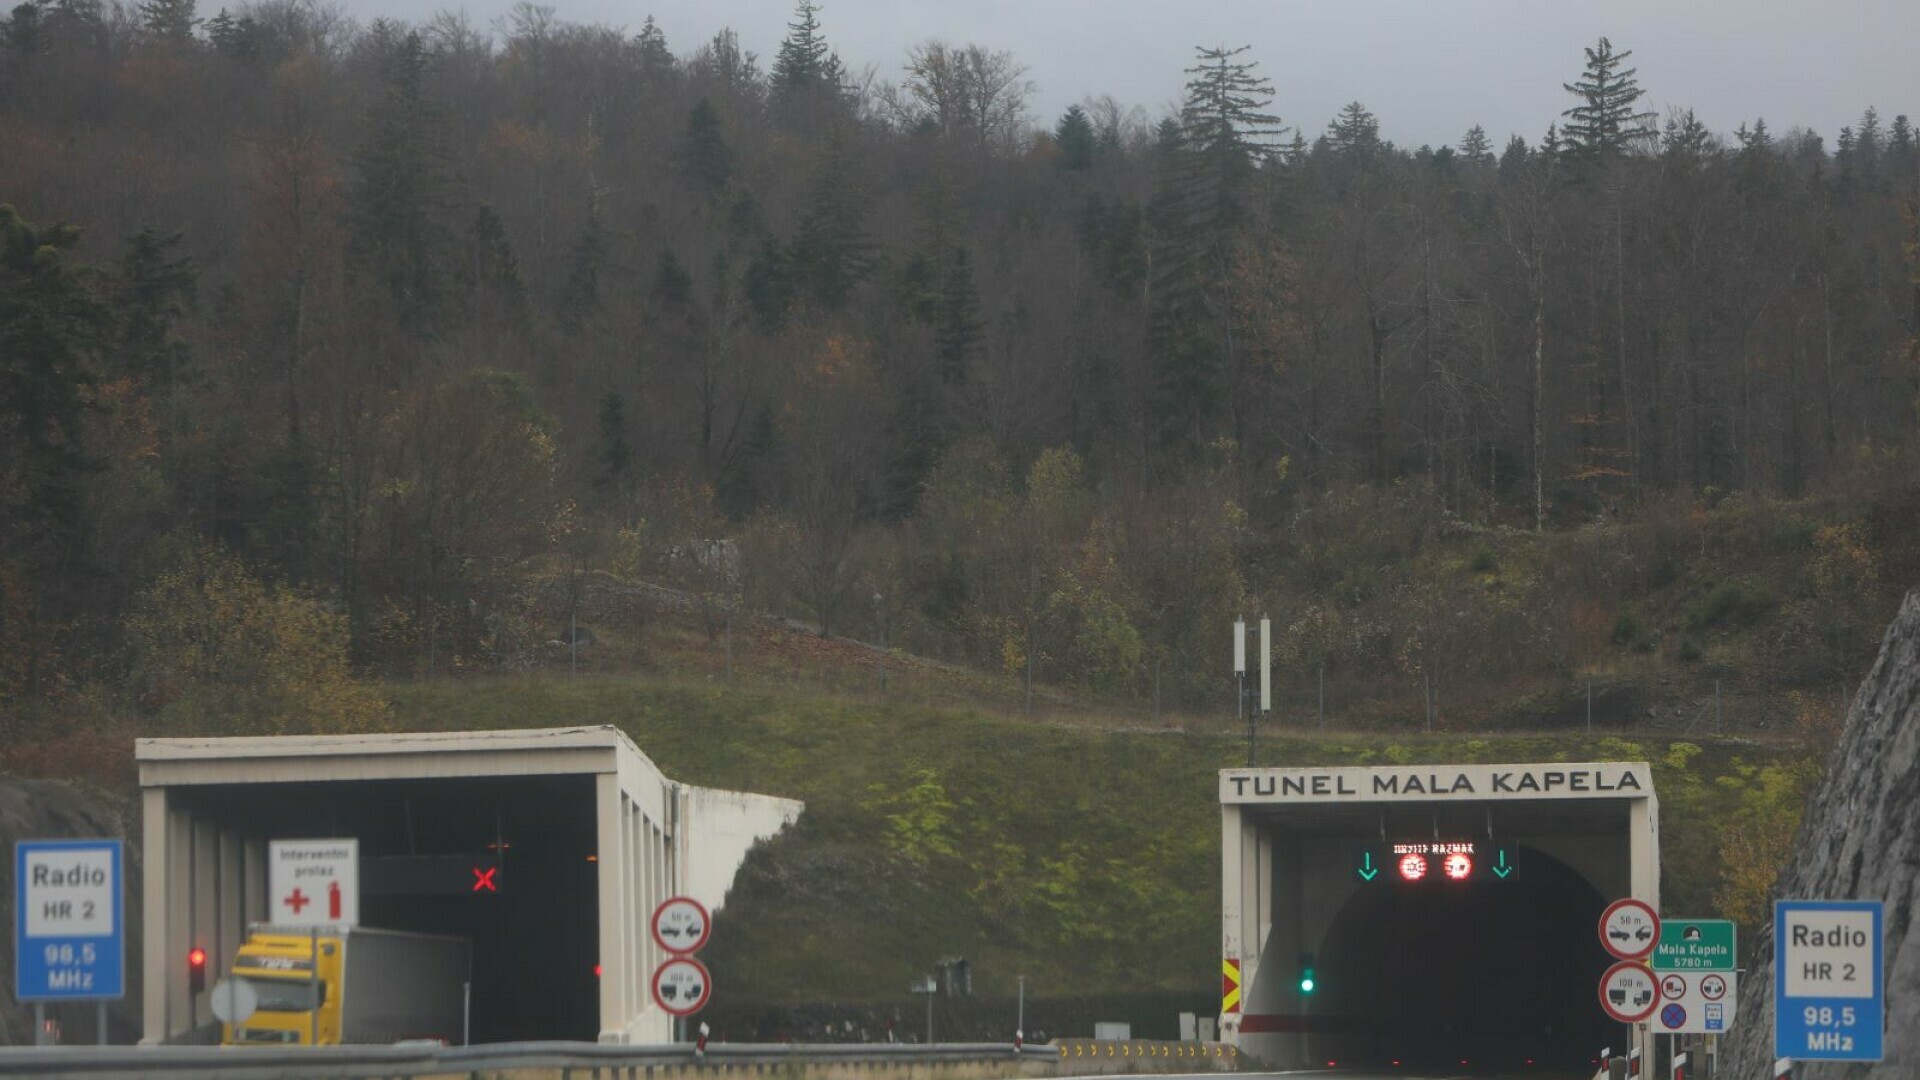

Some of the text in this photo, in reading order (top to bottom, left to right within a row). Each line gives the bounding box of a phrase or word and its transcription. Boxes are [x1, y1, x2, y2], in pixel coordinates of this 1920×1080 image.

[1230, 770, 1641, 796] TUNEL MALA KAPELA
[281, 848, 349, 860] Interventni
[33, 864, 105, 887] Radio
[295, 865, 334, 879] prolaz
[44, 901, 96, 920] HR 2
[1620, 916, 1631, 925] 50
[1793, 924, 1867, 948] Radio
[45, 943, 96, 966] 98,5
[1659, 943, 1727, 957] Mala Kapela
[1674, 959, 1700, 967] 5780
[1803, 963, 1856, 981] HR 2
[48, 968, 94, 990] MHz
[1620, 979, 1632, 988] 100
[1804, 1006, 1856, 1028] 98,5
[1808, 1032, 1853, 1051] MHz
